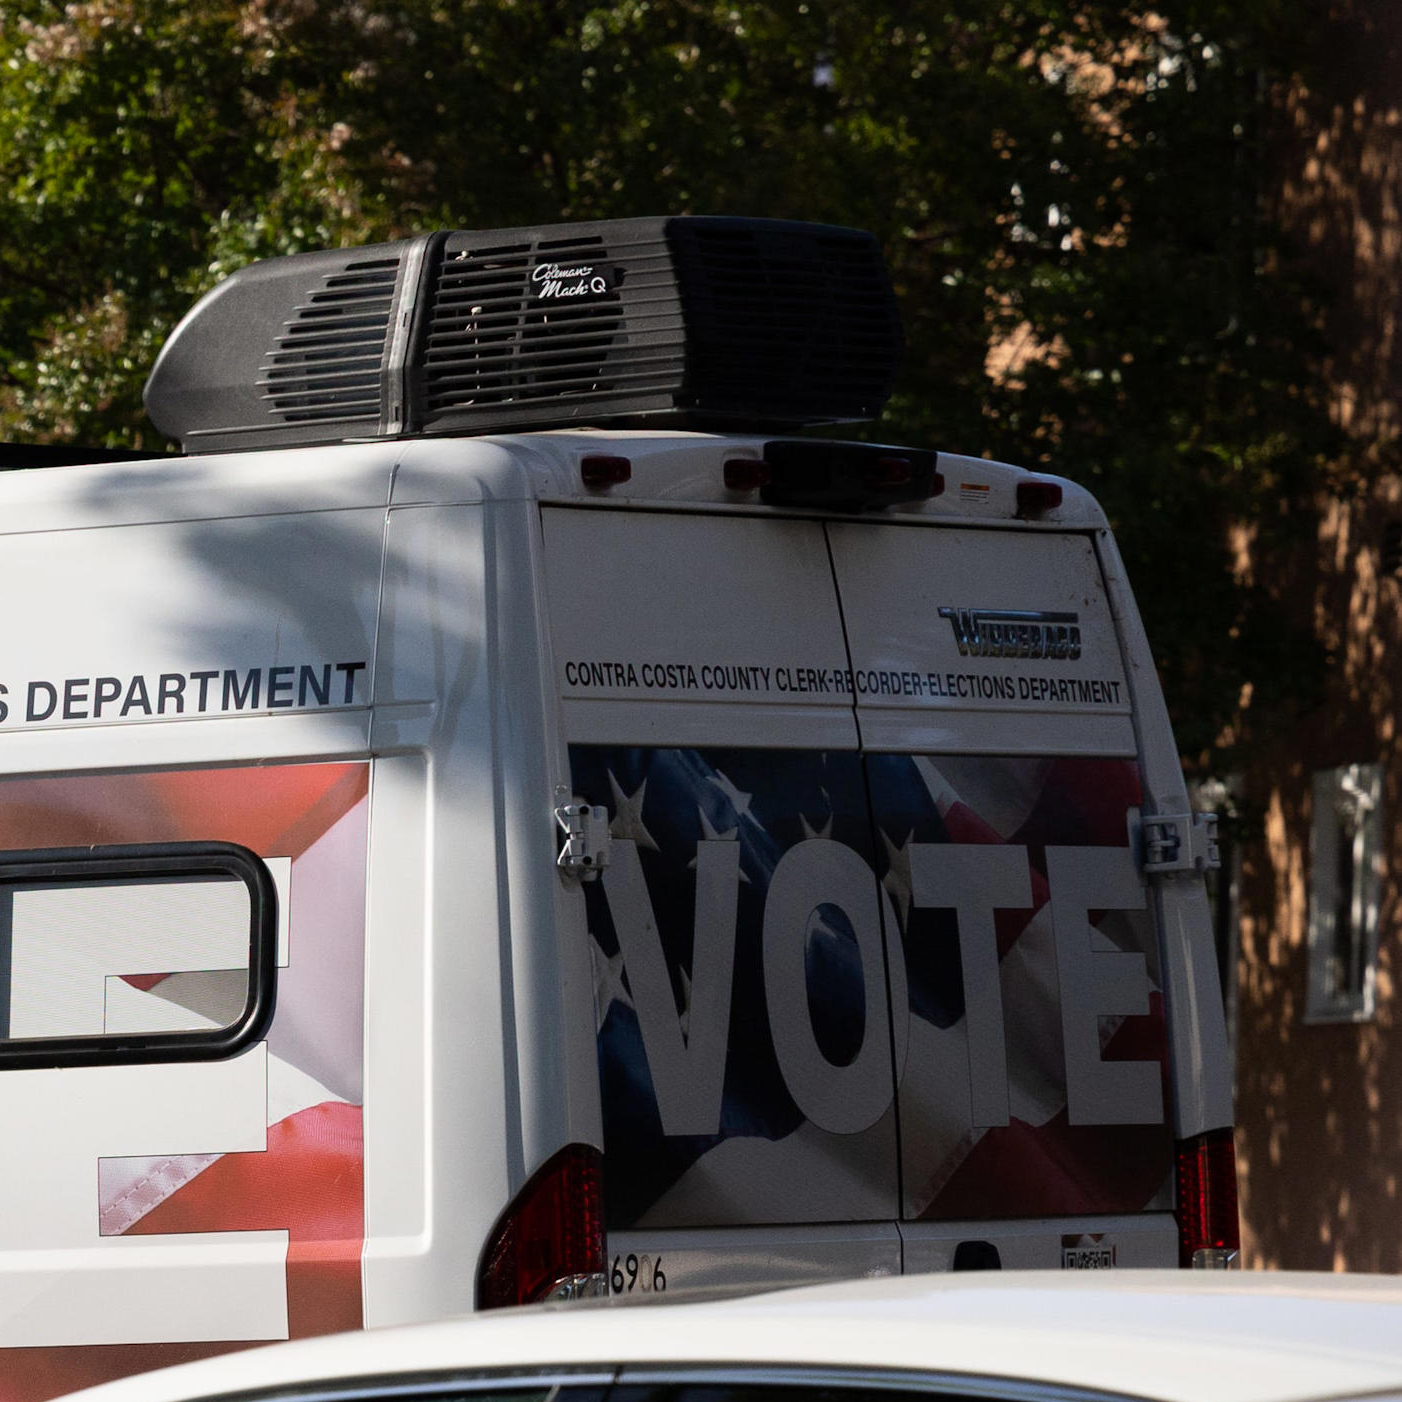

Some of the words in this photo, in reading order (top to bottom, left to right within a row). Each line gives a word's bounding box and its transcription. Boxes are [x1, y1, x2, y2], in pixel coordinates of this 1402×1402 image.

[590, 276, 607, 293] Q
[25, 661, 367, 722] DEPARTMENT
[565, 661, 639, 687] CONTRA
[642, 663, 698, 689] COSTA
[701, 665, 771, 691] COUNTY
[775, 667, 1015, 700] CLERK-RECORDER-ELECTIONS
[1018, 677, 1121, 704] DEPARTMENT
[600, 838, 1165, 1136] VOTE
[611, 1253, 667, 1294] 6906
